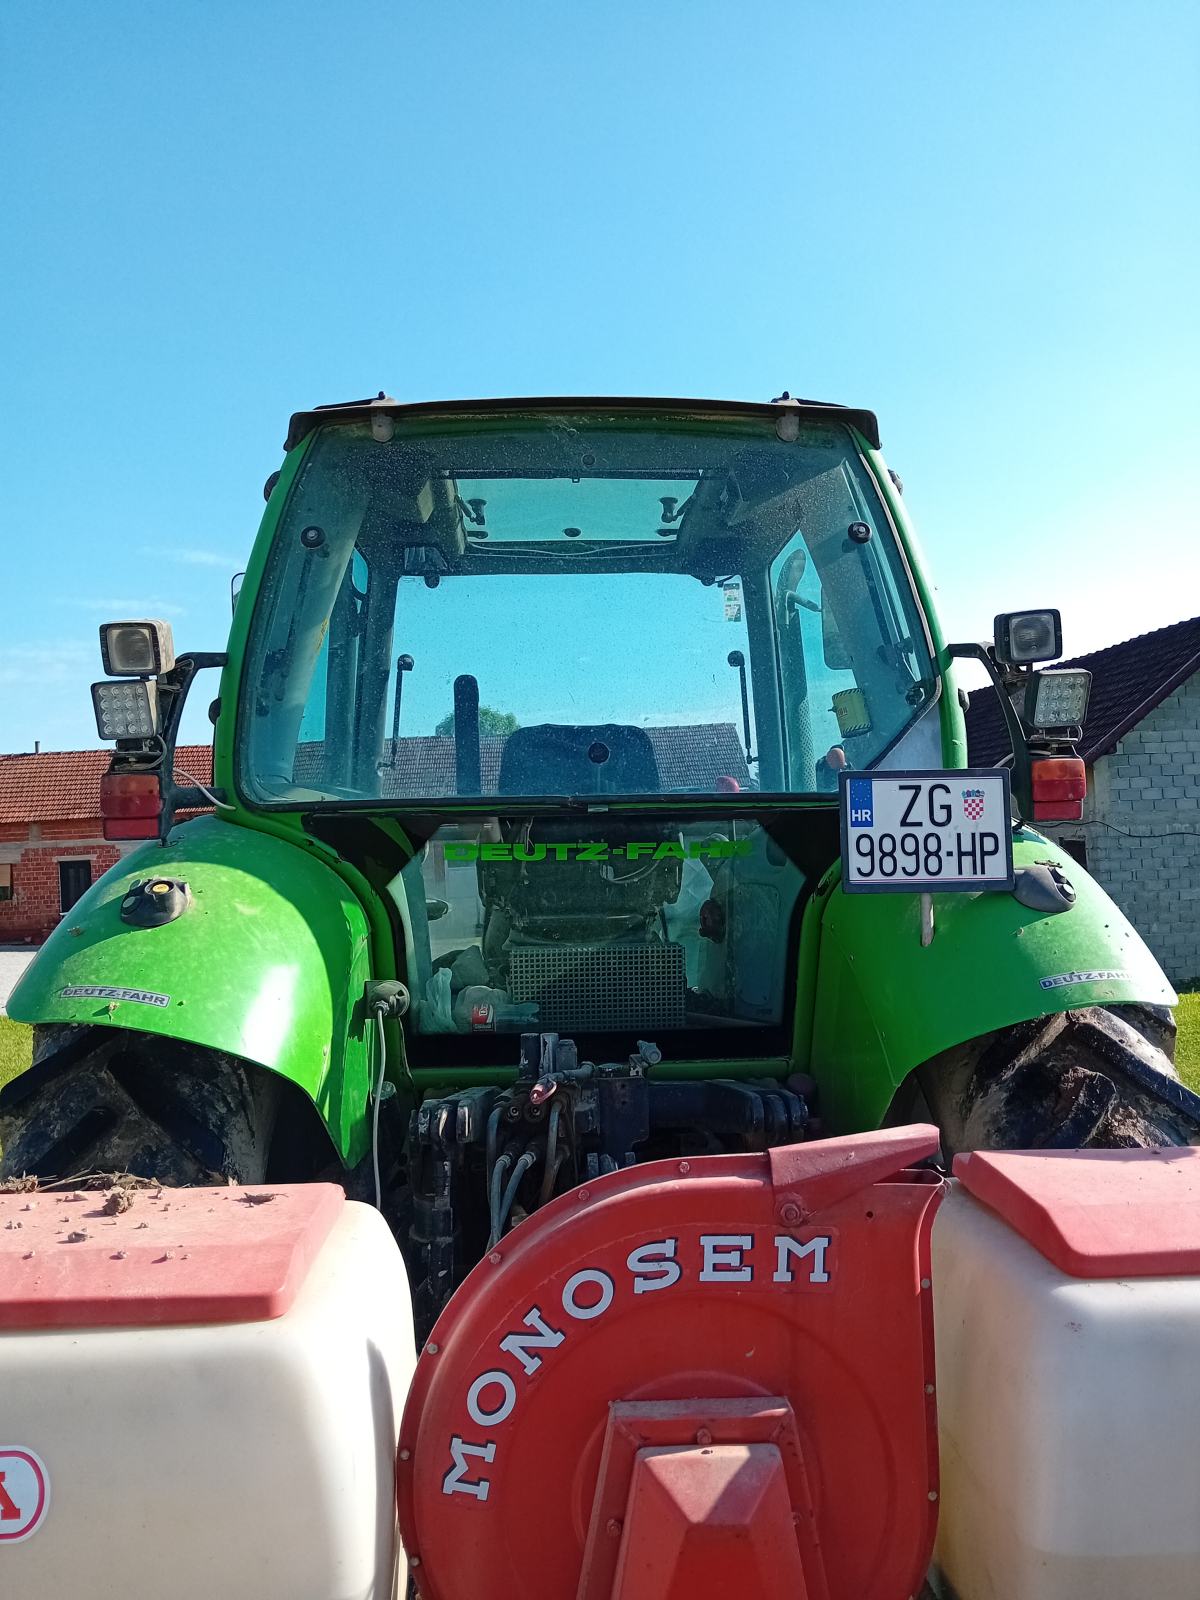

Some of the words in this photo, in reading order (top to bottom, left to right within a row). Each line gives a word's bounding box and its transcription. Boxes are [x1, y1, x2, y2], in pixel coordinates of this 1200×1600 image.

[851, 809, 872, 822] HR
[898, 783, 952, 828] ZG
[855, 832, 1000, 878] 9898-HP
[62, 988, 166, 1005] DEUTZ-FAHR
[442, 1233, 831, 1501] MONOSEM
